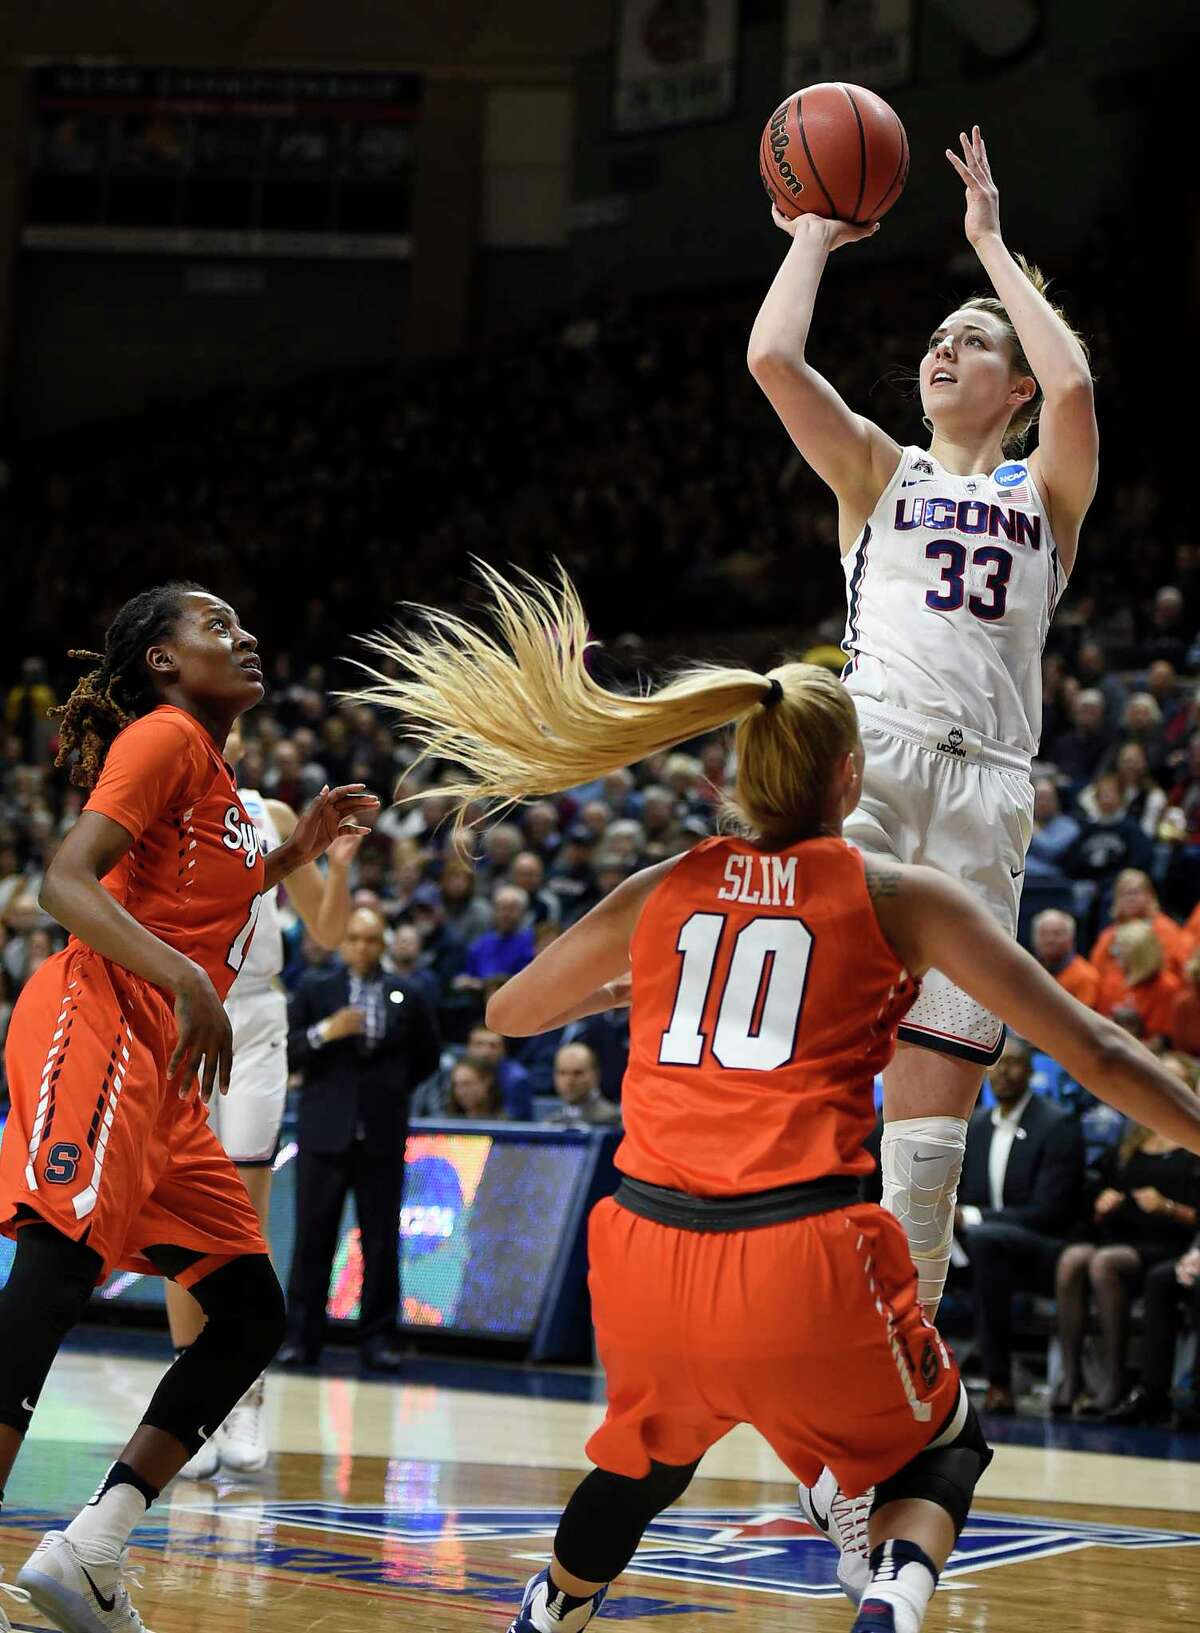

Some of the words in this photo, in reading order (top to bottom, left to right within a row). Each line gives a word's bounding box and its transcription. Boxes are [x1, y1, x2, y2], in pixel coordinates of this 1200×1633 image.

[770, 101, 804, 197] Wilson
[999, 470, 1026, 483] NCAA
[894, 497, 1041, 551] UCONN
[924, 539, 1013, 620] 33
[936, 742, 967, 758] UCONN
[718, 853, 798, 906] SLIM
[658, 911, 816, 1072] 10
[44, 1142, 81, 1184] S
